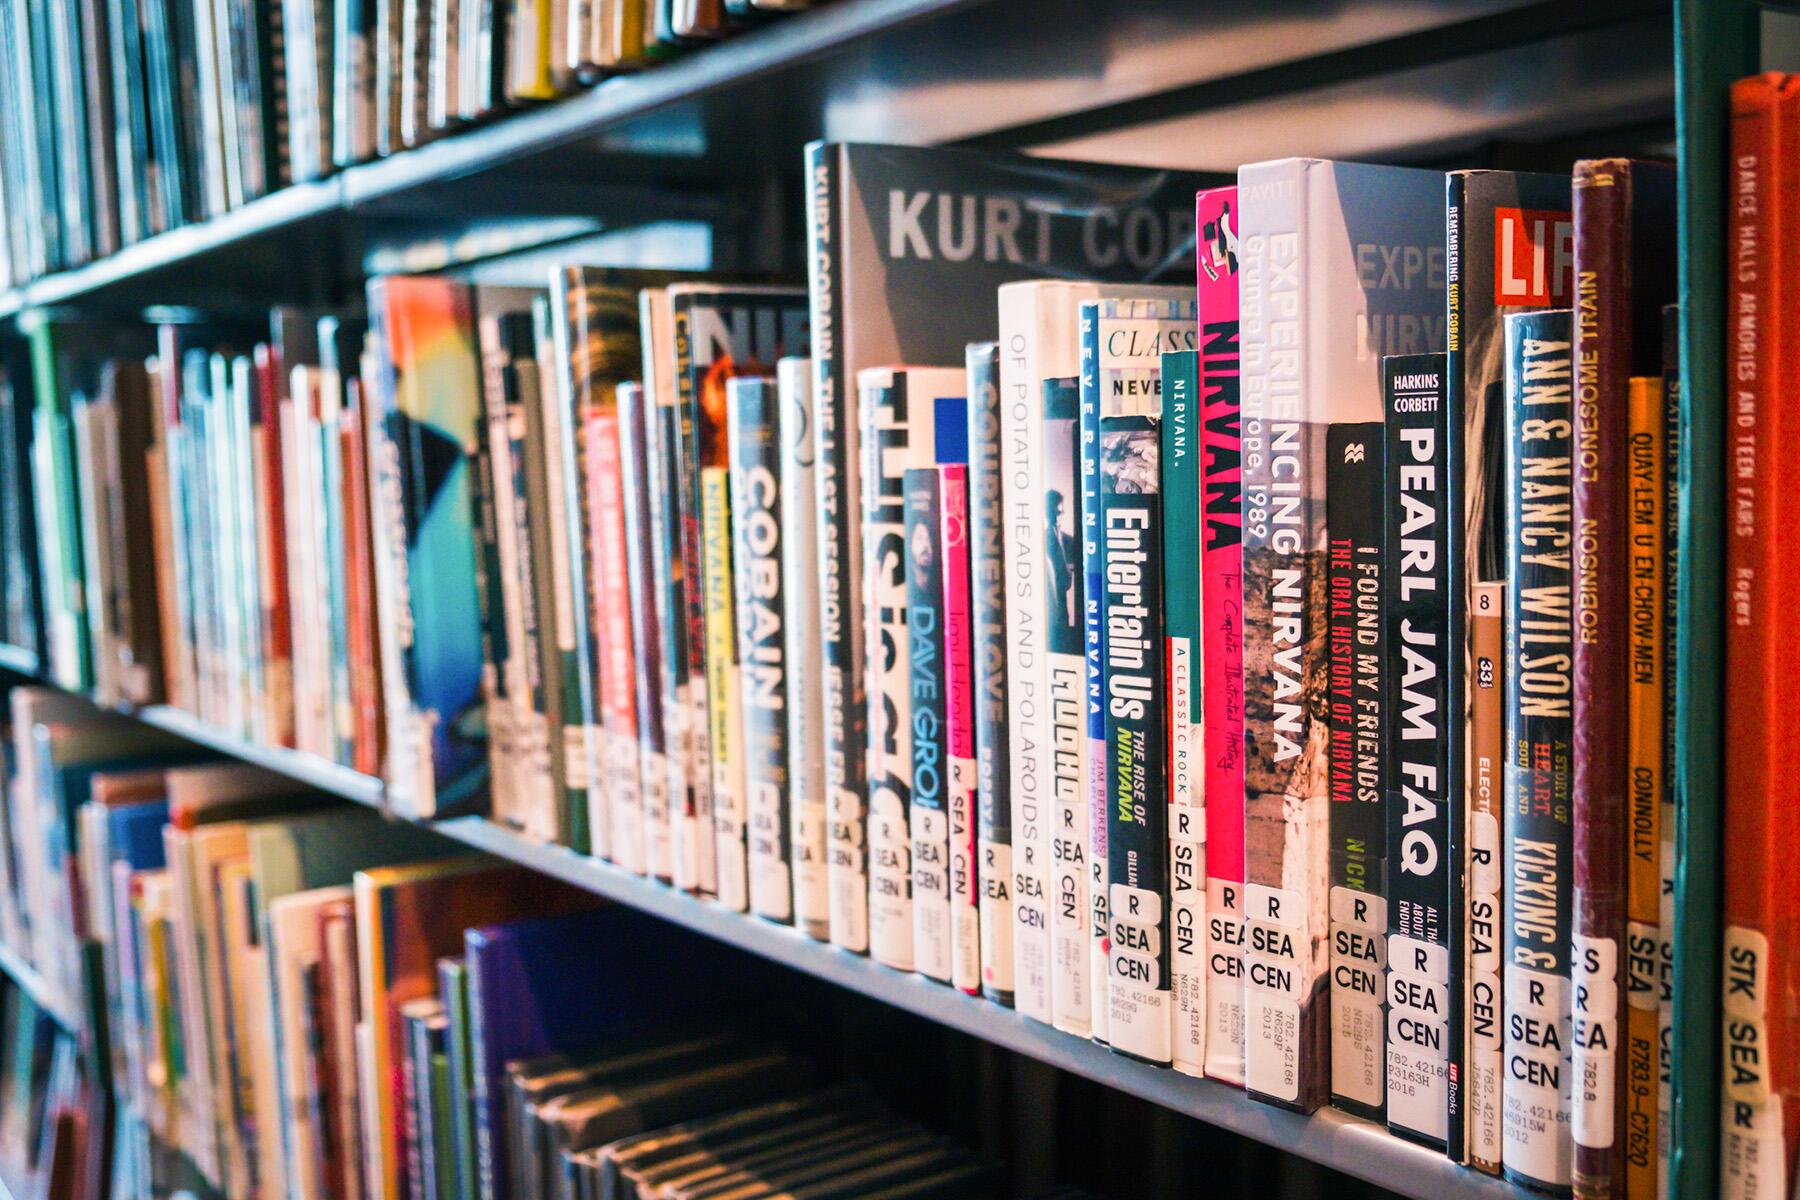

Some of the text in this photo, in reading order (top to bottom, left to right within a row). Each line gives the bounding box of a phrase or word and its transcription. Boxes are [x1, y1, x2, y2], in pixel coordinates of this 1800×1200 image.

[815, 166, 831, 244] KURT
[1244, 180, 1296, 201] PAVITT
[1738, 155, 1758, 217] DANCE
[889, 190, 1063, 265] KURT
[1357, 244, 1447, 290] EXPE
[1501, 218, 1573, 297] LIF
[1738, 225, 1758, 283] HALLS
[1449, 206, 1460, 352] REMEMBERING KURT COBAIN
[1108, 329, 1197, 358] CLASS
[1737, 292, 1758, 382] ARMORIES
[1113, 380, 1161, 396] NEVE
[1243, 235, 1268, 539] Grunge Europe, 1989
[1394, 373, 1439, 391] HARKINS
[1579, 271, 1599, 483] LONESOME TRAIN
[1173, 379, 1186, 468] NIRVANA.
[1394, 396, 1439, 413] CORBETT
[1737, 390, 1756, 428] AND
[1203, 320, 1242, 553] NIRVANA
[1736, 435, 1756, 479] TEEN
[1081, 319, 1101, 714] NEVERMIND NIRVANA
[1269, 232, 1302, 763] EXPERIENCING NIRVANA
[1519, 338, 1572, 718] ANN & NANCY WILSON
[747, 465, 785, 710] COBAIN
[1010, 335, 1038, 841] OF POTATO HEADS AND POLAROIDS
[1579, 519, 1599, 645] ROBINSON
[1106, 508, 1152, 720] Entertain Us
[1356, 563, 1379, 647] FOUND
[911, 605, 937, 700] DAVE
[1216, 562, 1242, 776] The Complete Illustrated History
[1400, 427, 1439, 877] PEARL JAM FAQ
[1630, 432, 1654, 863] QUAY-LEM U EN-CHOW-MEN CONNOLLY
[1331, 538, 1353, 803] THE ORAL HISTORY OF NIRVANA
[1356, 653, 1379, 692] MY
[1176, 648, 1187, 793] A CLASSIC ROCK
[1357, 699, 1380, 804] FRIENDS
[1117, 727, 1134, 823] NIRVANA
[1131, 730, 1146, 827] THE RISE OF
[1533, 742, 1552, 817] HEART,
[1554, 755, 1568, 800] STORY
[951, 796, 965, 836] SEA
[1064, 808, 1073, 829] R
[1518, 783, 1529, 816] AND
[1554, 804, 1568, 824] OF
[924, 816, 932, 834] R
[986, 850, 995, 868] R
[1025, 846, 1034, 866] R
[1053, 838, 1085, 865] SEA
[1346, 838, 1366, 891] NICK
[952, 853, 967, 895] CEN
[1016, 873, 1044, 900] SEA
[1092, 863, 1102, 884] R
[1175, 813, 1194, 956] R SEA CEN
[1513, 837, 1557, 944] KICKING
[1018, 904, 1045, 931] CEN
[1061, 874, 1076, 919] CEN
[1092, 894, 1108, 939] SEA
[1129, 894, 1140, 916] R
[1223, 886, 1236, 910] R
[1268, 896, 1281, 920] R
[1354, 898, 1367, 923] R
[1427, 905, 1438, 924] ALL
[1115, 923, 1150, 952] SEA
[1412, 902, 1424, 938] ABOUT
[1252, 926, 1295, 960] SEA
[1335, 930, 1379, 964] SEA
[1415, 948, 1429, 974] R
[1471, 847, 1494, 1039] R SEA CEN
[1628, 933, 1656, 993] SEA
[1115, 956, 1150, 983] CEN
[1250, 962, 1292, 993] CEN
[1335, 965, 1377, 996] CEN
[1729, 946, 1757, 1001] STK
[1394, 979, 1439, 1015] SEA
[1529, 980, 1545, 1007] R
[1576, 985, 1589, 1013] R
[1262, 1006, 1273, 1041] 2013
[1397, 1018, 1441, 1051] CEN
[1510, 1013, 1562, 1052] SEA
[1284, 1013, 1296, 1087] 782.42166
[1388, 1050, 1448, 1079] 782.42166
[1729, 1022, 1760, 1087] SEA
[1388, 1063, 1431, 1089] P3163H
[1388, 1079, 1416, 1098] 2016
[1448, 1063, 1458, 1116] LIFE Books
[1511, 1055, 1560, 1090] CEN
[1734, 1102, 1754, 1130] R
